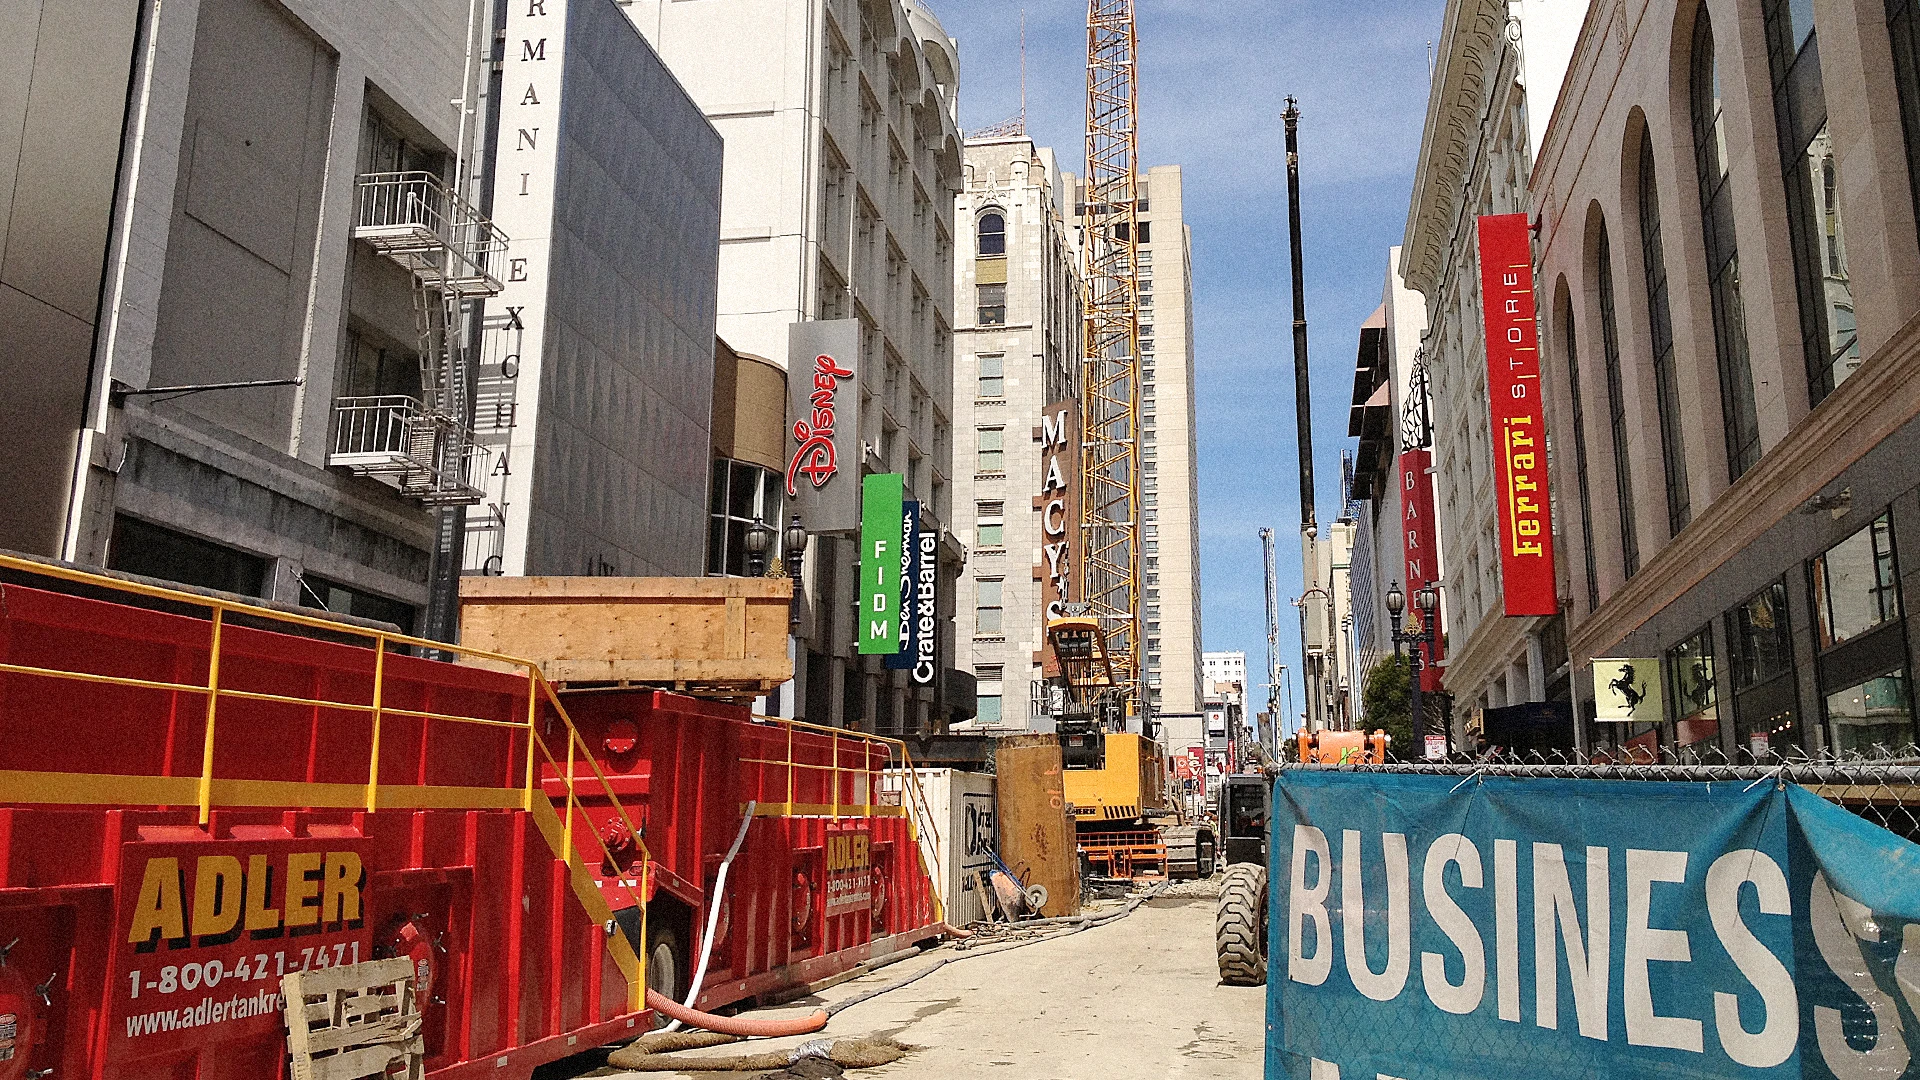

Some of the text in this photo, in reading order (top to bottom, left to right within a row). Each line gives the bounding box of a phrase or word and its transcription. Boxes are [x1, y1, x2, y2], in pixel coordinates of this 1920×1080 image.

[517, 0, 547, 195] RMANI
[1503, 416, 1543, 558] Ferrari
[870, 540, 888, 640] FIDM
[912, 532, 936, 684] Crate&Barrel
[1405, 471, 1426, 672] BARNES
[127, 851, 366, 953] ADLER
[827, 834, 870, 873] ADLER
[127, 941, 360, 999] 1-800-421-7471
